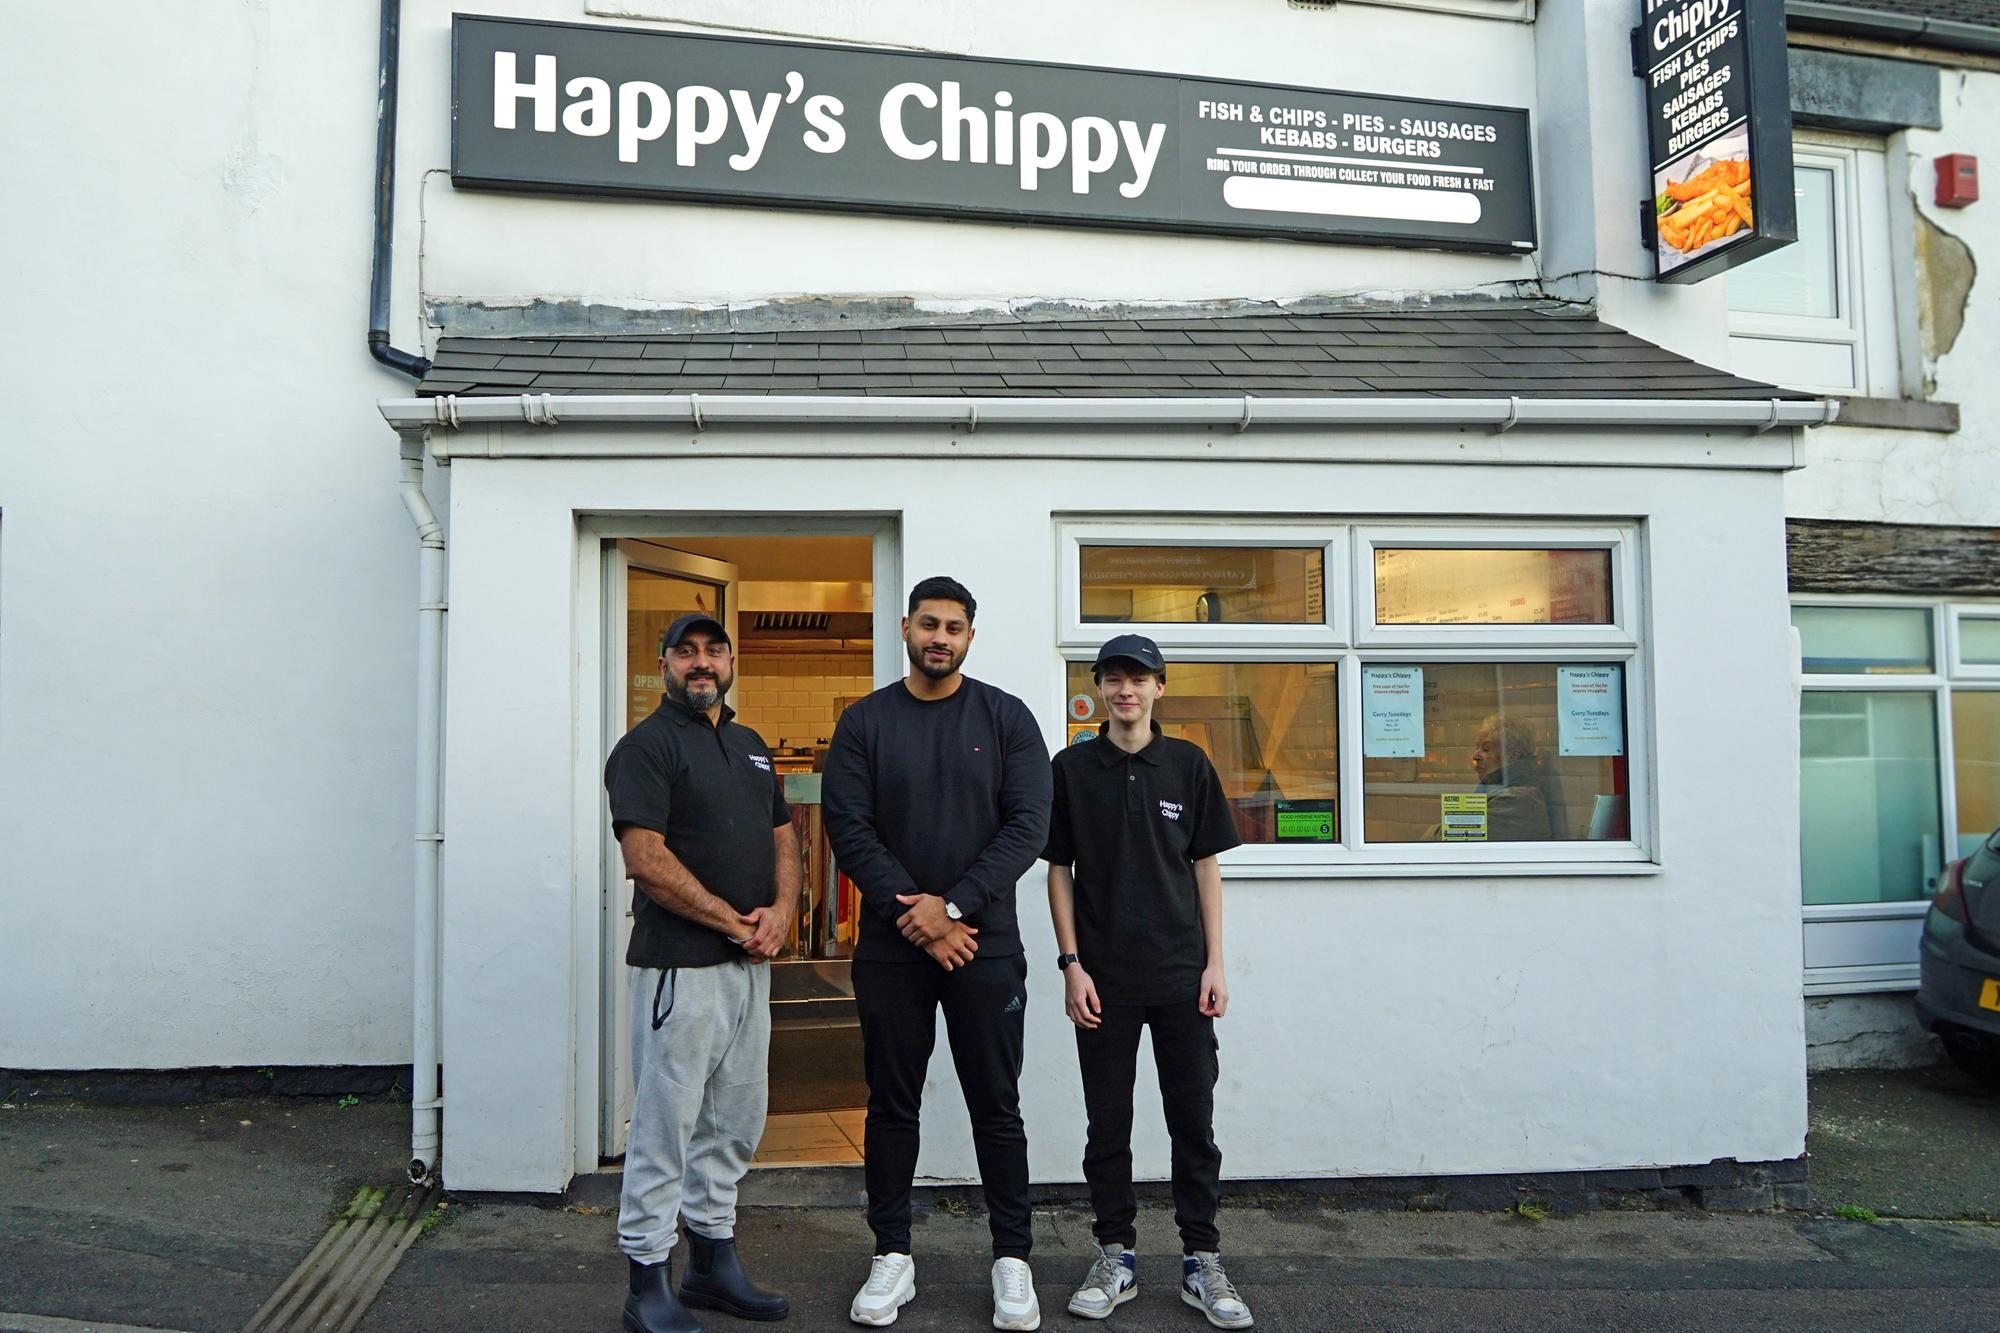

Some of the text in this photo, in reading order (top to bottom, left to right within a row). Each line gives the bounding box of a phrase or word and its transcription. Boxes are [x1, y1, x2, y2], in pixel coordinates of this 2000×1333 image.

[1653, 0, 1729, 51] Chippy
[1653, 20, 1738, 88] FISH & CHIPS
[1680, 59, 1710, 90] PIES
[1663, 65, 1731, 119] SAUSAGES
[1672, 90, 1724, 134] KEBABS
[493, 51, 1167, 199] Happy's Chippy
[1199, 101, 1243, 121] FISH
[1250, 105, 1264, 123] &
[1270, 107, 1327, 128] CHIPS
[1343, 113, 1385, 133] PIES
[1400, 118, 1497, 143] SAUSAGES
[1261, 127, 1338, 150] KEBABS
[1353, 135, 1441, 158] BURGERS
[1668, 106, 1729, 155] BURGERS
[1206, 158, 1495, 191] RING YOUR ORDER THROUGH COLLECT YOUR FOOD FRESH & FAST
[1322, 825, 1328, 833] 5
